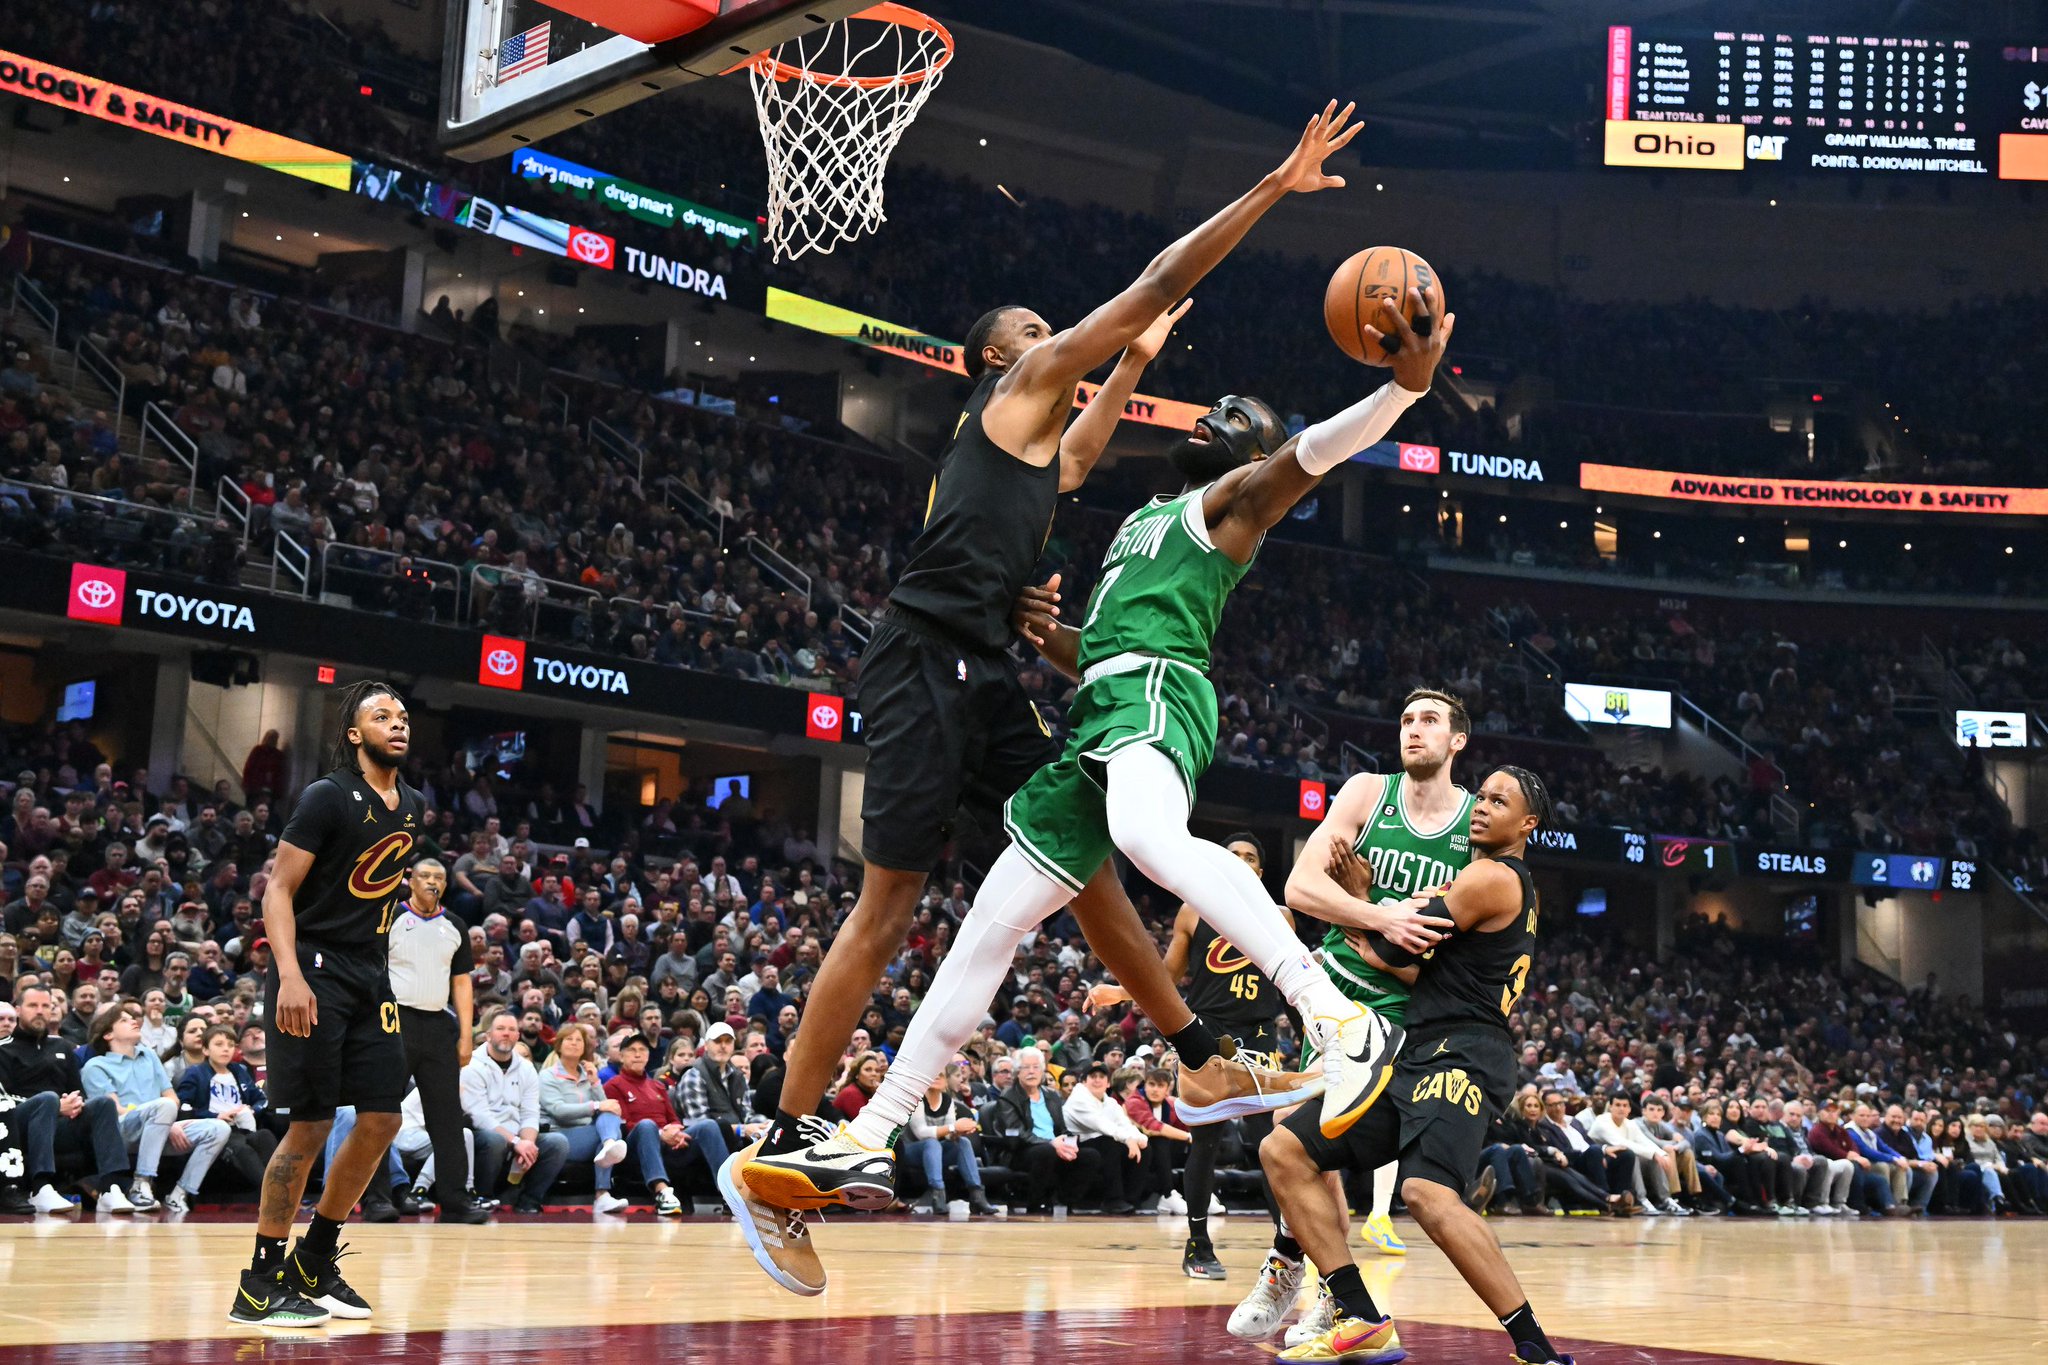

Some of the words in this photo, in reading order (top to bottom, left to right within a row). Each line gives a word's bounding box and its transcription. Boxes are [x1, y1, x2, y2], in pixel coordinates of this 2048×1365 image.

[106, 93, 127, 116] &
[133, 101, 231, 146] SAFETY
[1636, 111, 1664, 121] TEAM
[1667, 112, 1704, 122] TOTALS
[1634, 134, 1715, 156] Ohio
[1747, 135, 1786, 160] CAT
[1825, 134, 1868, 147] GRANT
[1934, 137, 1976, 151] THREE
[1863, 156, 1923, 170] DONOVAN
[558, 171, 595, 190] mart
[604, 183, 638, 209] drug
[639, 197, 674, 218] mart
[624, 246, 727, 300] TUNDRA
[858, 323, 955, 365] ADVANCED
[1076, 387, 1088, 404] &
[1448, 451, 1544, 481] TUNDRA
[1671, 479, 1774, 499] ADVANCED
[1781, 486, 1913, 504] TECHNOLOGY
[1920, 491, 1934, 505] &
[1938, 492, 2009, 508] SAFETY
[1082, 563, 1125, 629] 7
[136, 589, 256, 632] TOYOTA
[533, 656, 629, 694] TOYOTA
[1606, 691, 1628, 711] 811
[352, 791, 362, 801] 6
[1383, 805, 1395, 816] 6
[1449, 842, 1469, 853] PRINT
[1450, 834, 1469, 845] VISTA
[1626, 846, 1644, 862] 49
[1704, 846, 1713, 868] 1
[1758, 852, 1826, 874] STEALS
[1872, 858, 1887, 882] 2
[1952, 872, 1971, 889] 52
[1229, 973, 1259, 1000] 45
[1412, 1068, 1483, 1116] CAVS
